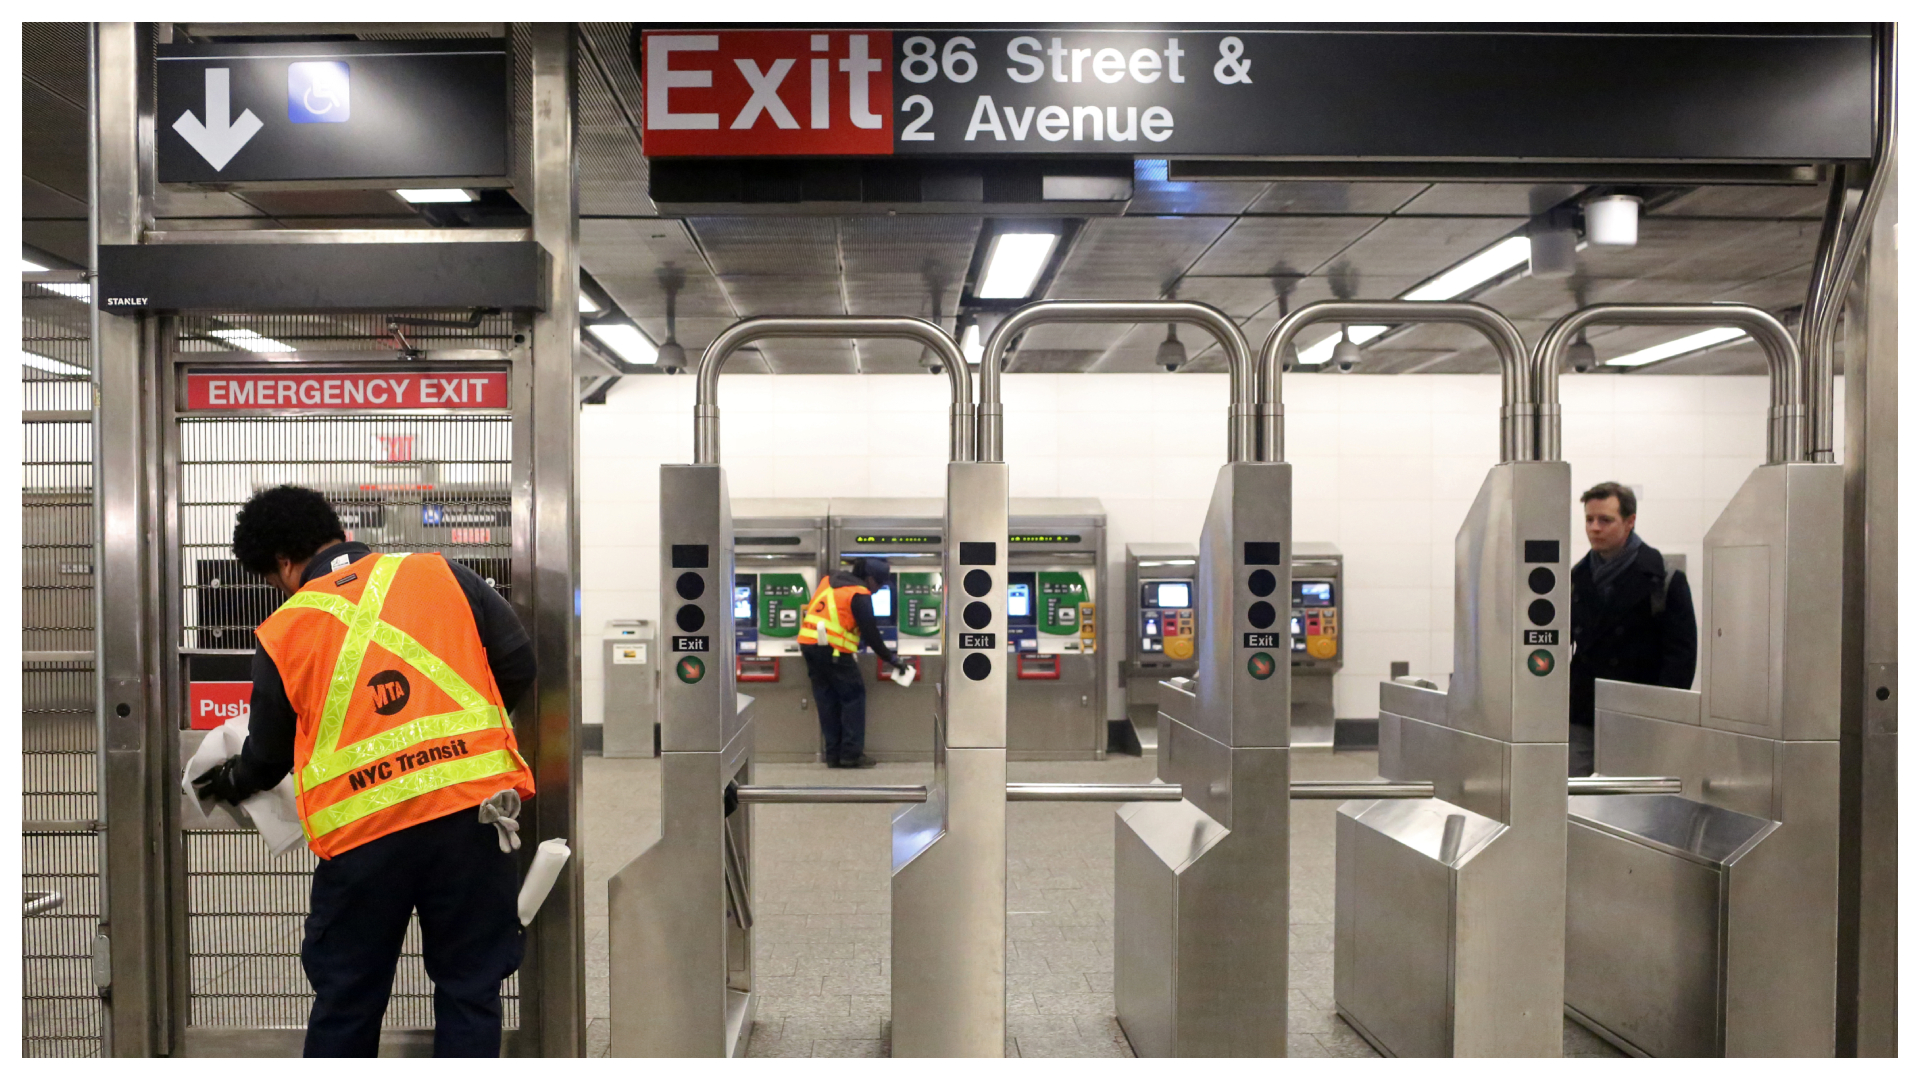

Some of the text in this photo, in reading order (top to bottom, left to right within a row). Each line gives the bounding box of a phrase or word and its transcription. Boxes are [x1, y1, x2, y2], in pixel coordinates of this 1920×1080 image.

[900, 36, 1254, 85] 86 Street &
[647, 34, 884, 130] Exit
[900, 95, 1175, 142] 2 Avenue
[107, 297, 149, 306] STANLEY
[207, 378, 489, 405] EMERGENCY EXIT
[678, 638, 703, 650] Exit
[964, 635, 989, 647] Exit
[1249, 634, 1273, 646] Exit
[1529, 631, 1552, 643] Exit
[367, 681, 405, 709] MTA
[200, 699, 251, 717] Push
[349, 739, 469, 791] NYC Transit
